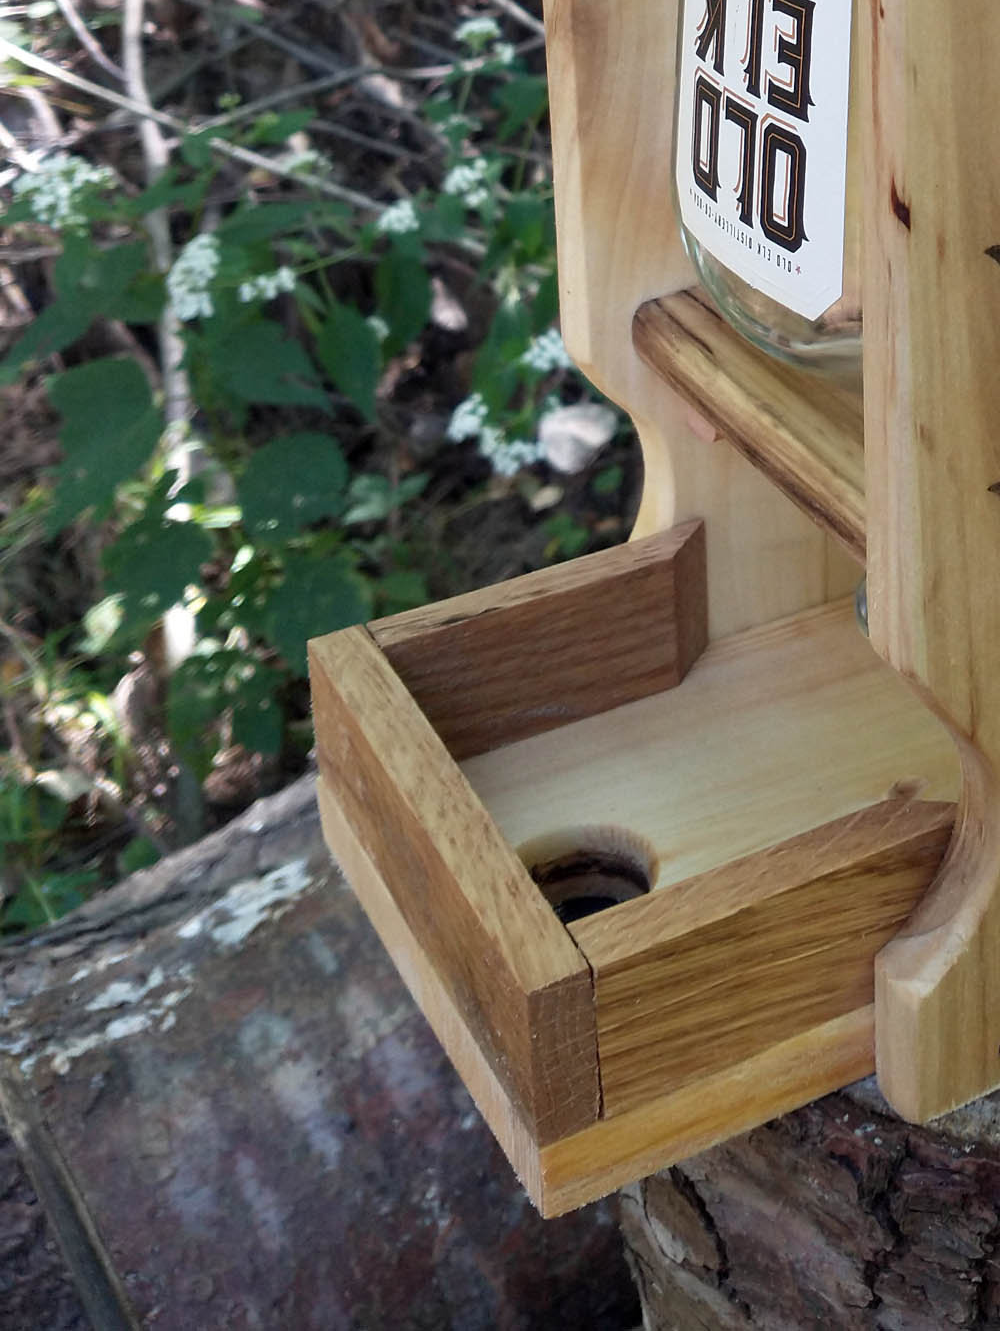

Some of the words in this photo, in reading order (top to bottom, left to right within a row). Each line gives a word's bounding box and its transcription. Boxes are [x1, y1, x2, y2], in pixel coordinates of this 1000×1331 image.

[692, 75, 810, 253] OLD
[758, 243, 771, 262] ELK
[777, 254, 792, 273] OLD
